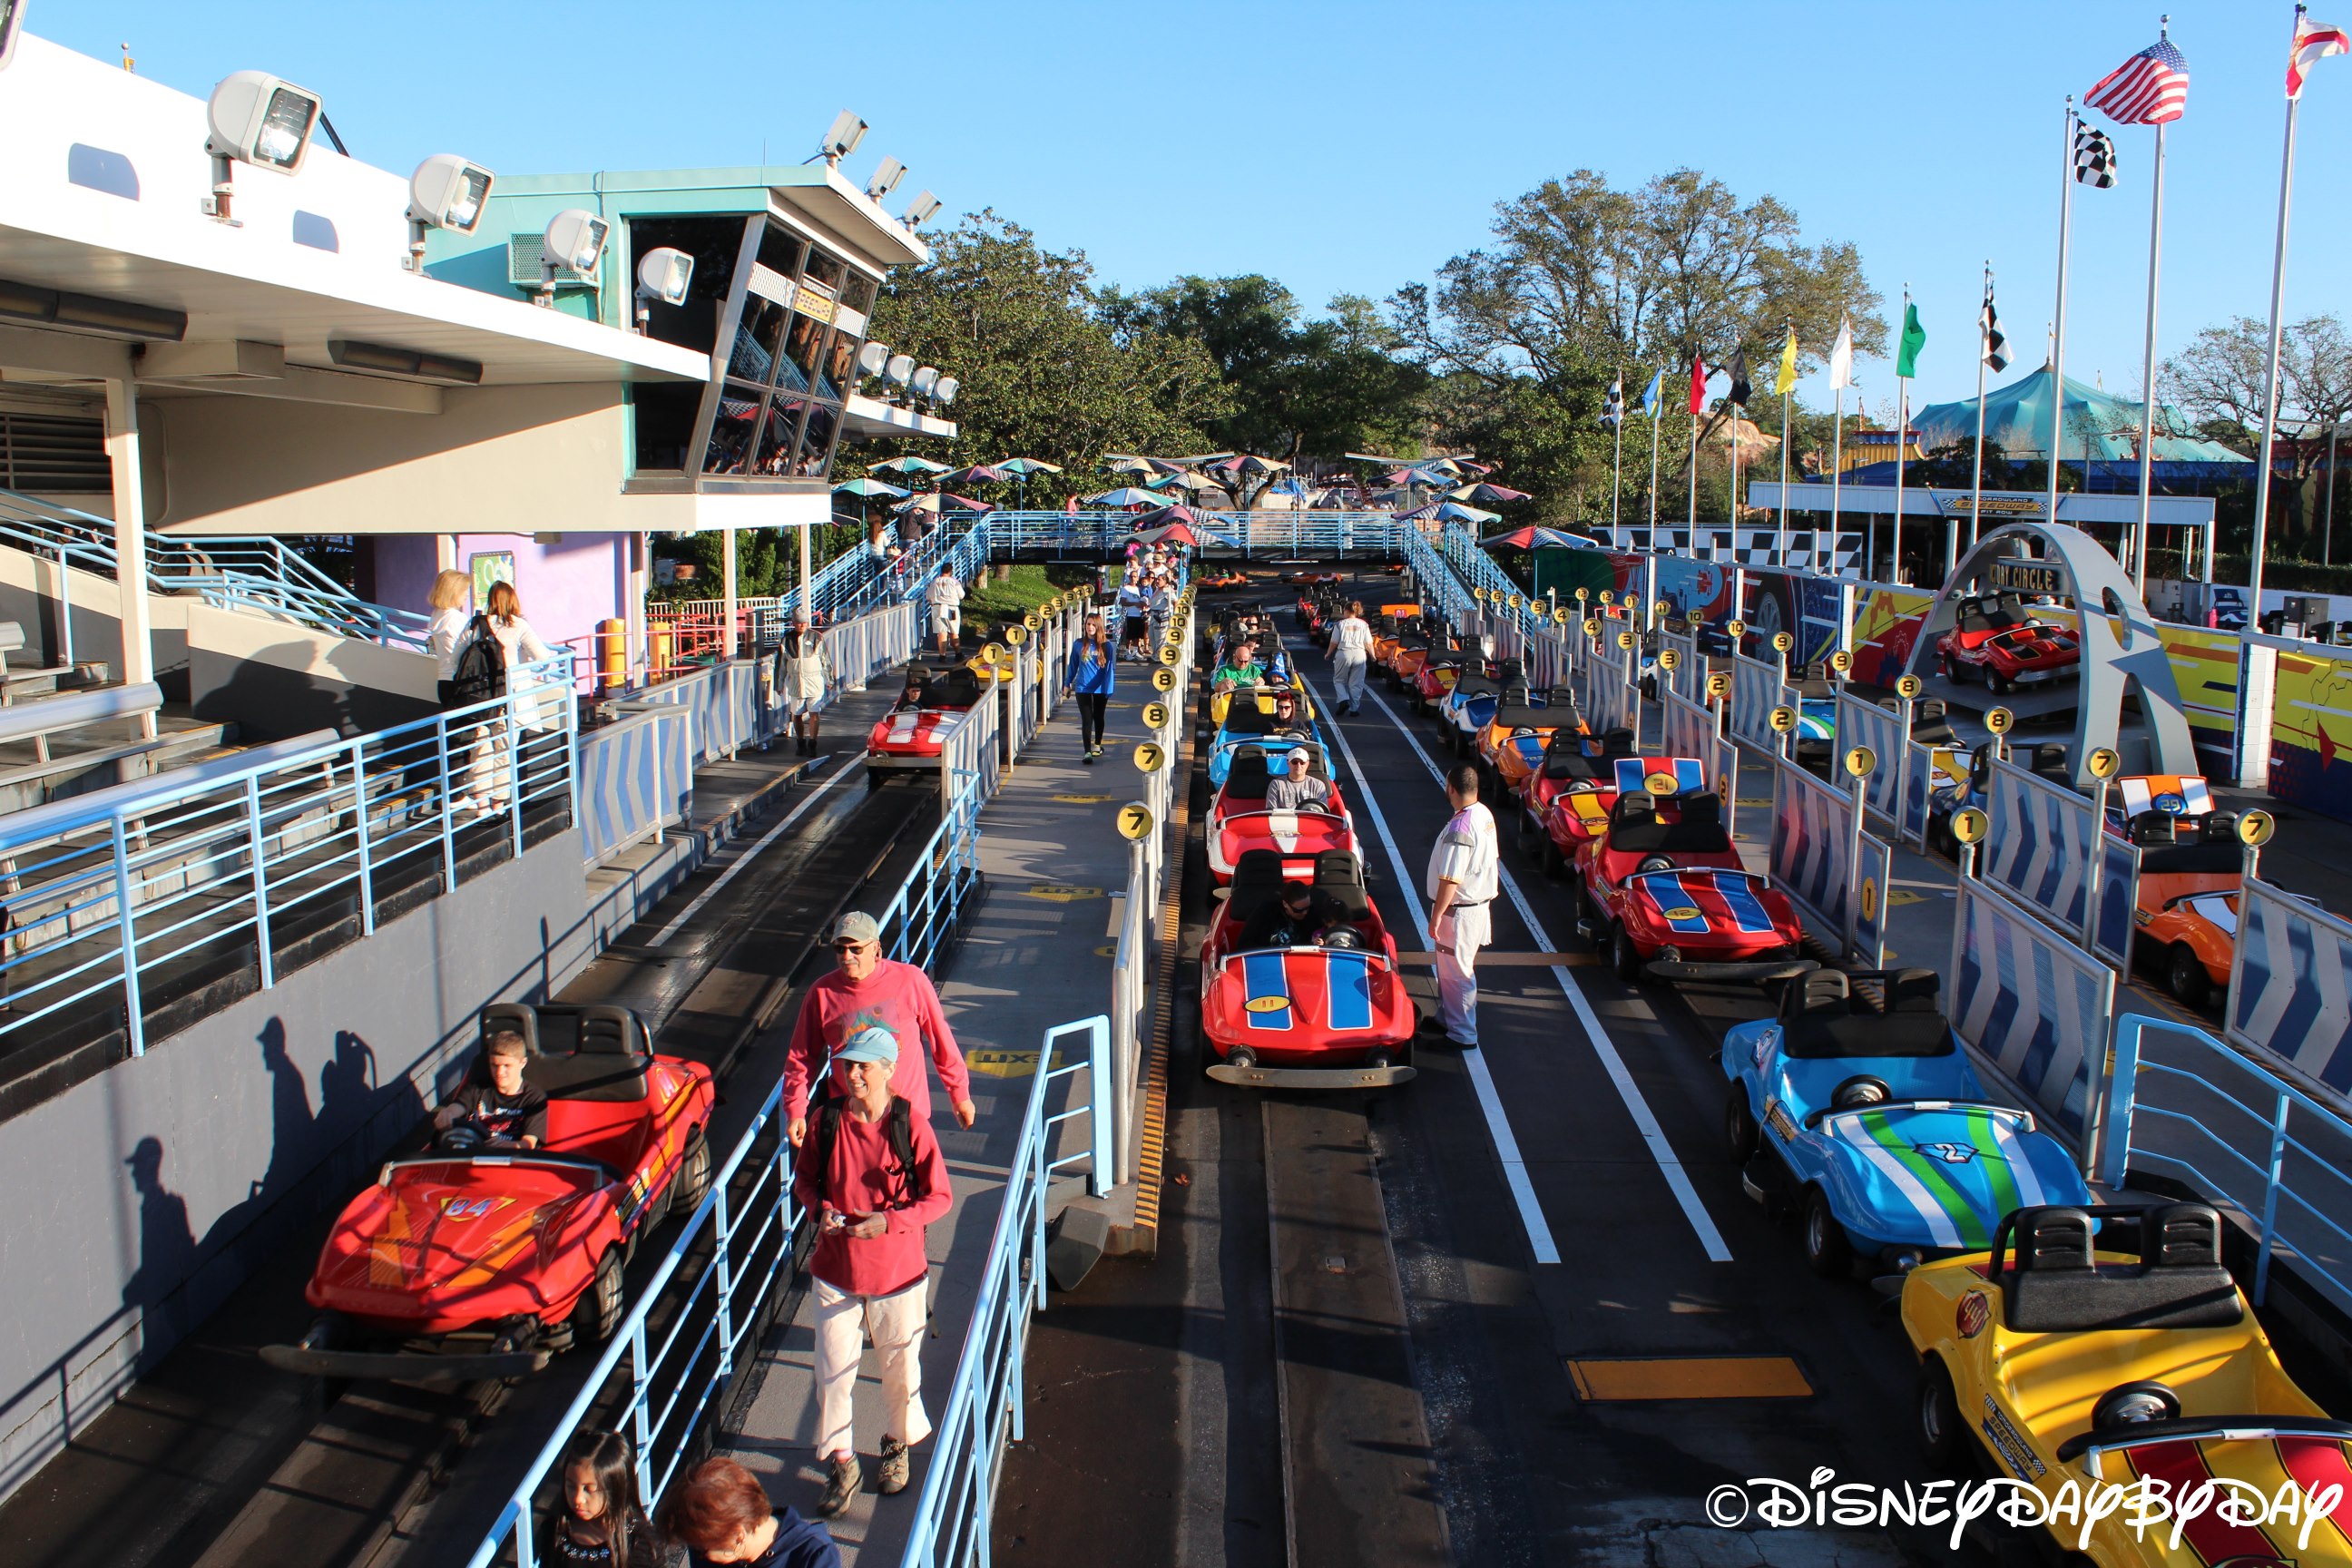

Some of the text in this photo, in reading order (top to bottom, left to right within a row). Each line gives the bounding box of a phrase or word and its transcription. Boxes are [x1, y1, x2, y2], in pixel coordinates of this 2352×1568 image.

[2013, 566, 2053, 590] CIRCLE
[1056, 600, 1063, 608] 3
[1627, 597, 1634, 605] 11
[1044, 607, 1052, 615] 2
[1177, 606, 1189, 614] 10
[1534, 603, 1543, 612] 5
[1558, 611, 1567, 619] 4
[1690, 612, 1701, 621] 10
[1029, 617, 1038, 626] 2
[1172, 617, 1185, 626] 10
[1588, 622, 1597, 631] 4
[1731, 623, 1744, 632] 10
[1014, 631, 1018, 640] 1
[1171, 632, 1180, 641] 9
[1623, 636, 1632, 644] 3
[1779, 637, 1788, 647] 9
[991, 649, 995, 659] 1
[1166, 650, 1176, 661] 9
[1666, 654, 1675, 663] 3
[1838, 656, 1847, 665] 9
[1160, 674, 1171, 685] 8
[1713, 678, 1724, 690] 2
[1903, 681, 1914, 691] 8
[1150, 709, 1163, 721] 8
[1776, 711, 1788, 725] 2
[1993, 714, 2004, 726] 8
[1142, 750, 1156, 764] 7
[1856, 754, 1863, 769] 1
[2096, 756, 2111, 769] 7
[1128, 813, 1144, 829] 7
[1965, 817, 1973, 833] 1
[2248, 818, 2264, 836] 7
[1866, 887, 1871, 911] 1
[445, 1198, 492, 1217] 84
[1996, 1411, 2033, 1458] TOMORROWLAND
[1989, 1416, 2033, 1471] SPEEDWAY
